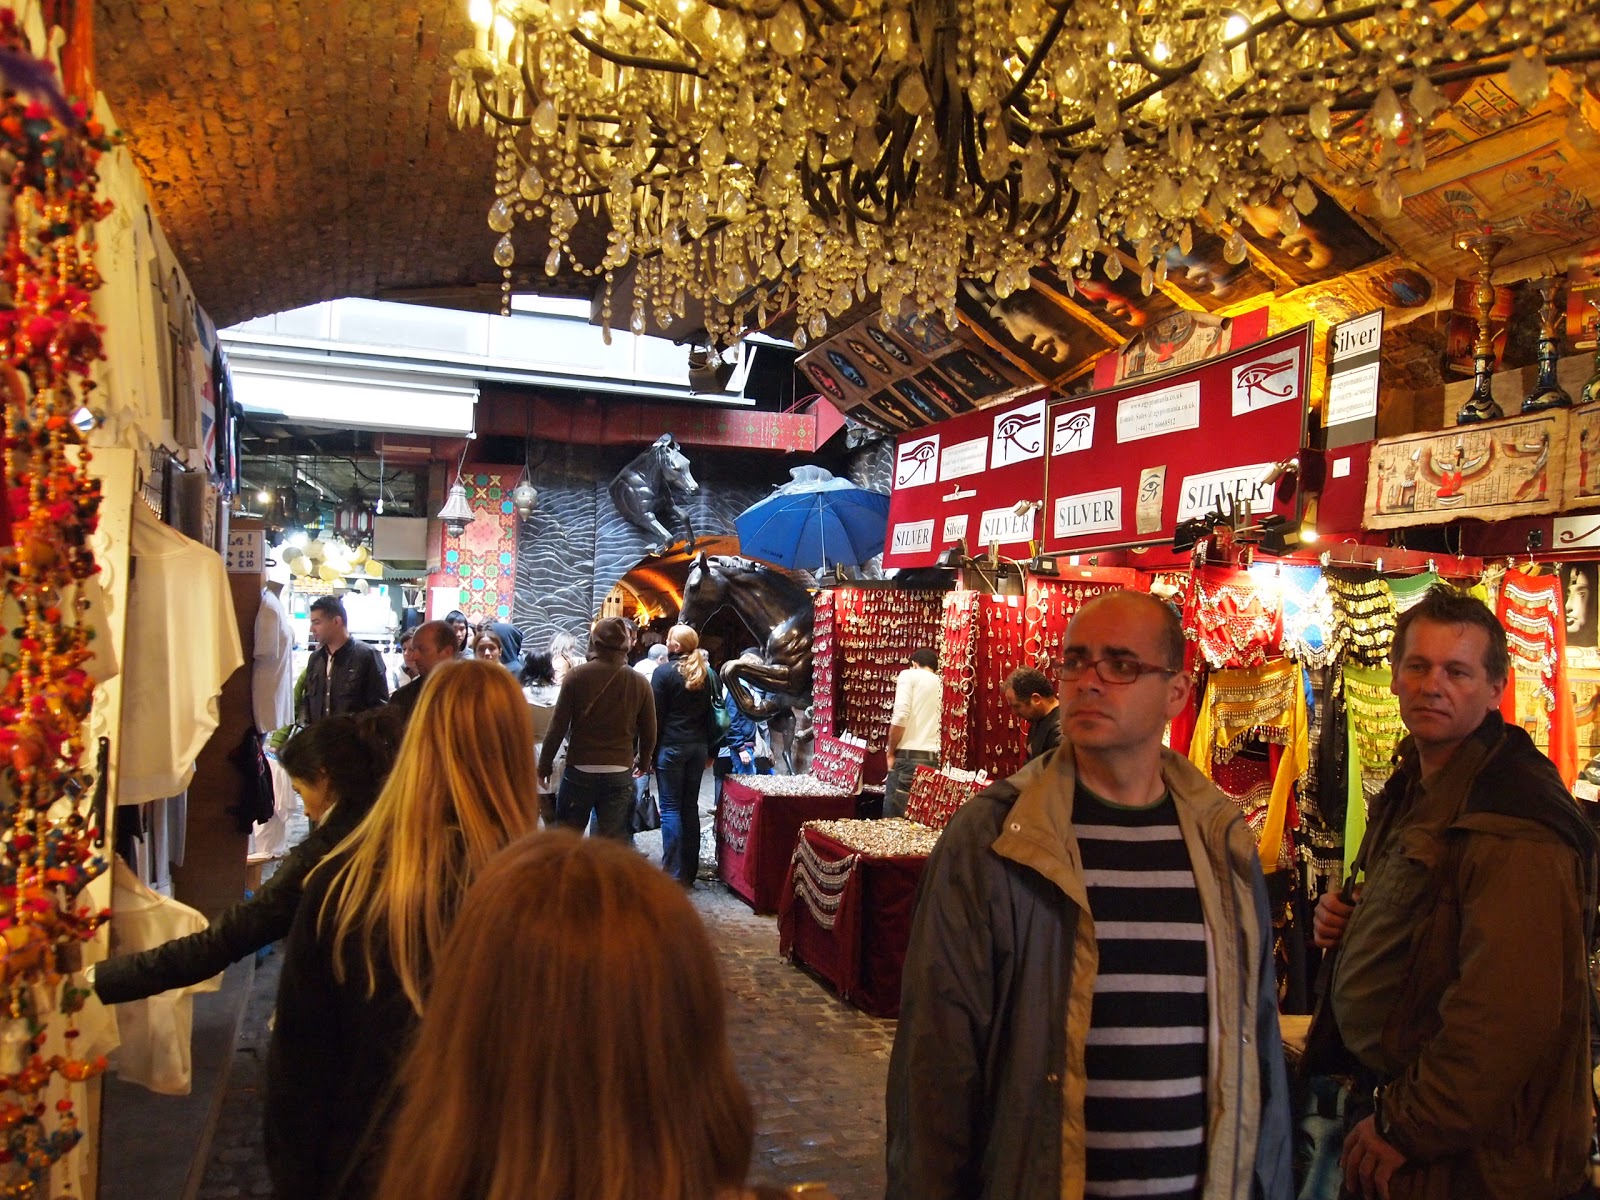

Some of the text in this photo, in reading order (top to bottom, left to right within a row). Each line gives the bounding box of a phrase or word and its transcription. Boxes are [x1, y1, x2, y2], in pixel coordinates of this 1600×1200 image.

[1331, 327, 1376, 355] Silver
[1186, 479, 1265, 509] SILVER
[983, 514, 1029, 536] SILVER
[1059, 500, 1115, 527] SILVER
[895, 528, 930, 546] SILVER
[945, 522, 965, 536] Silver
